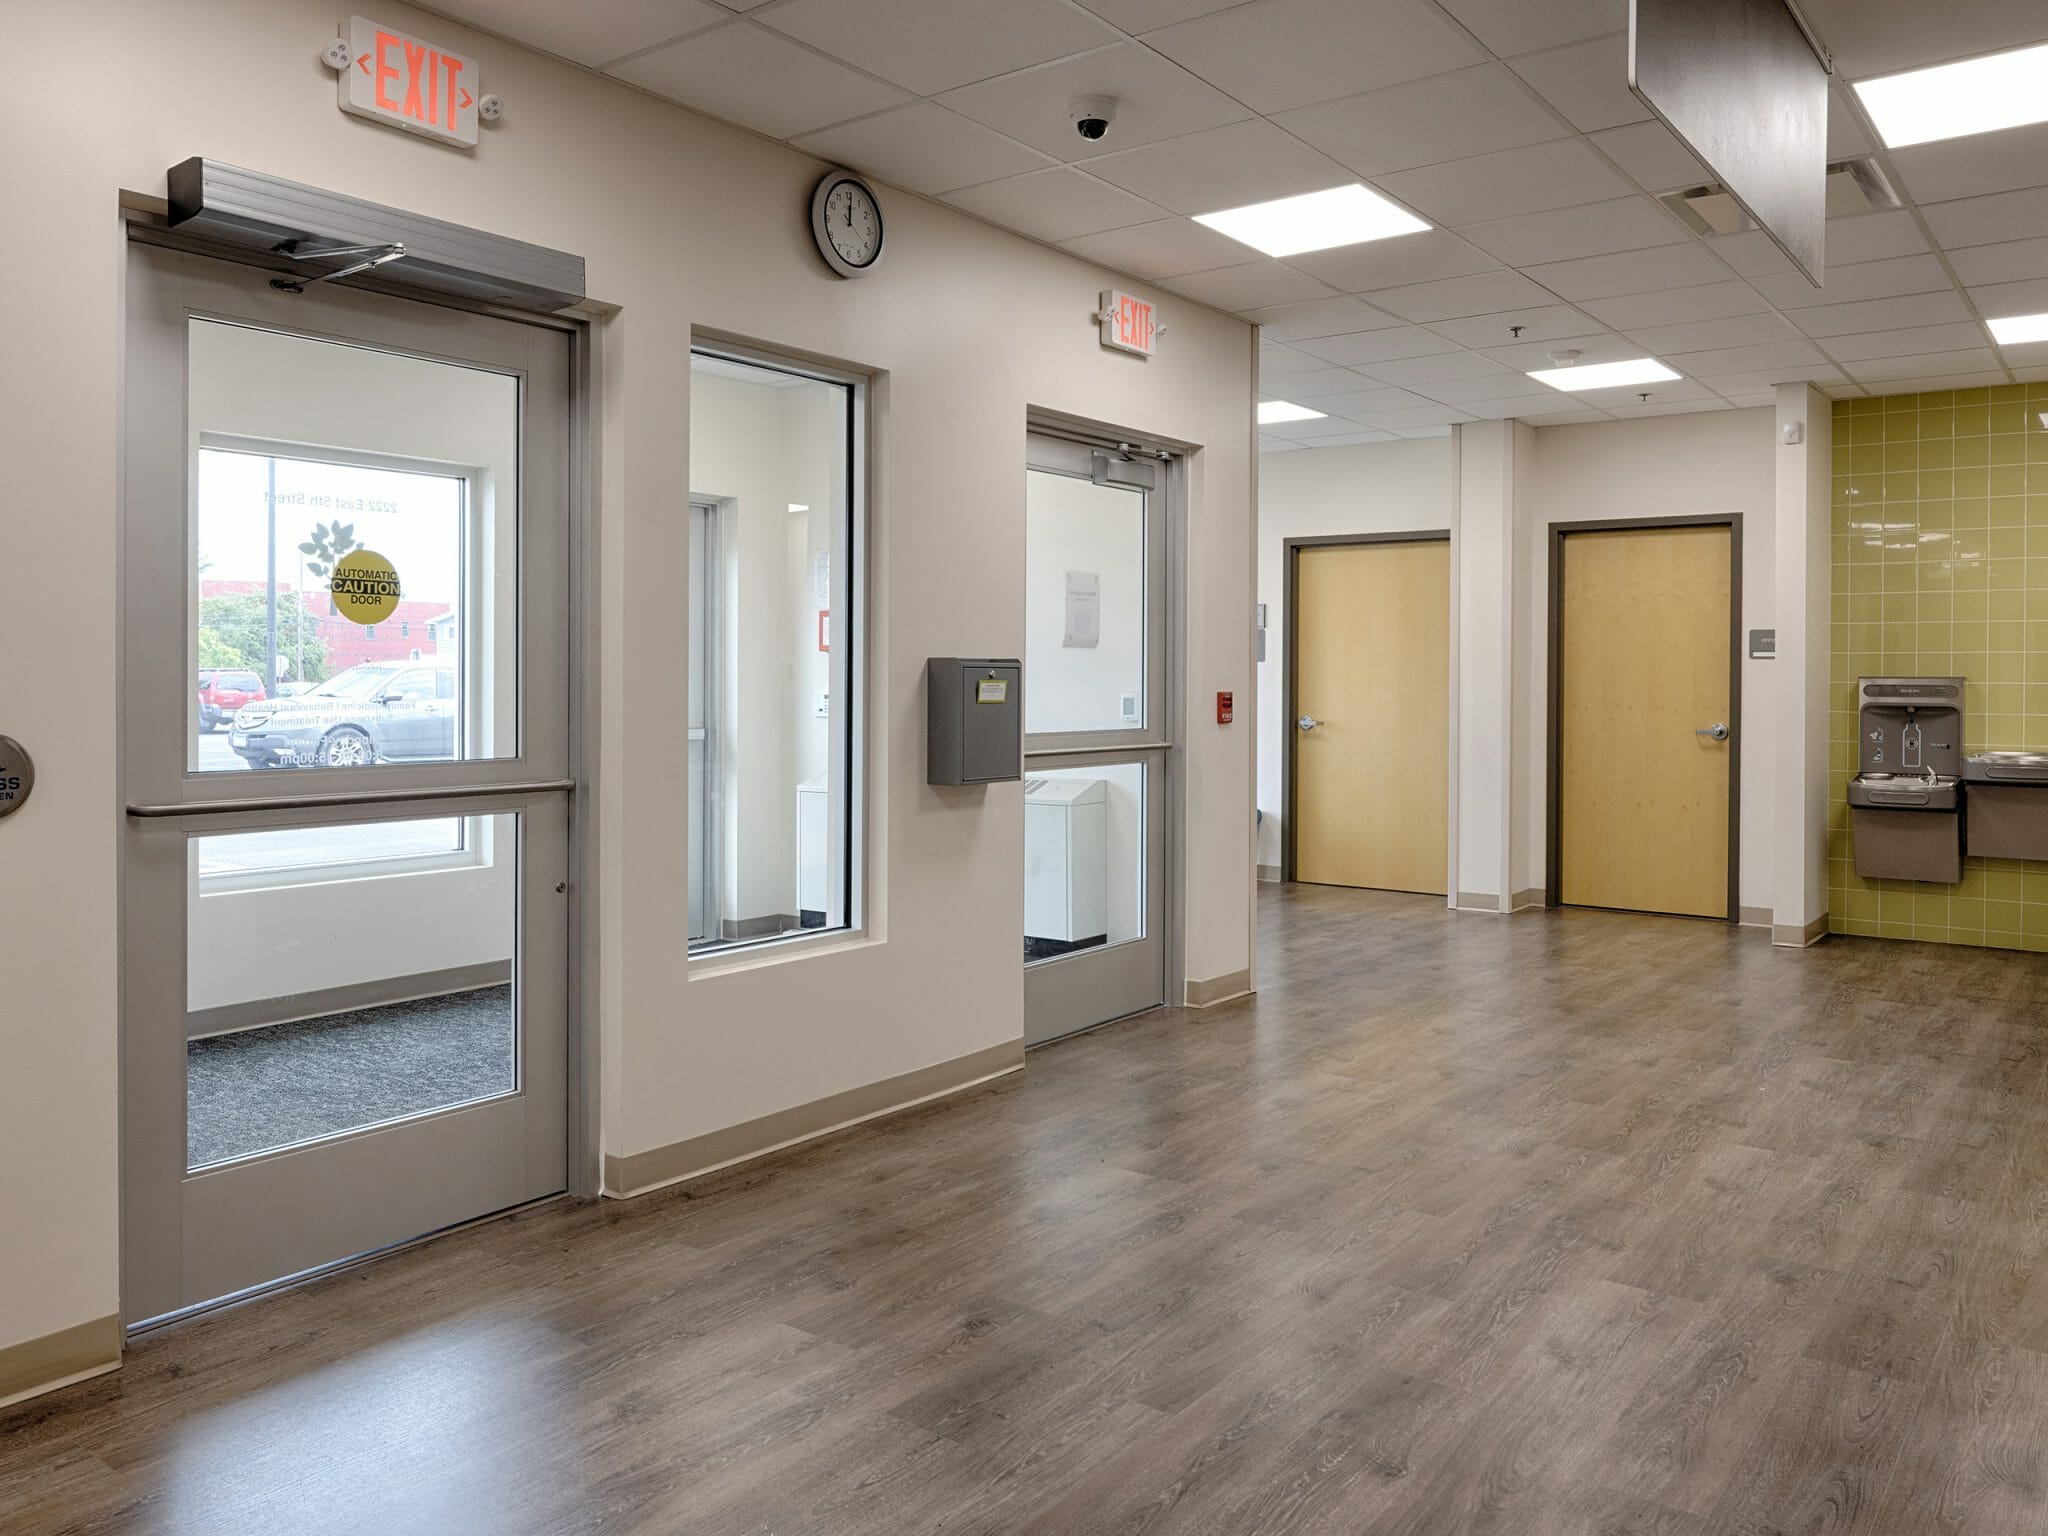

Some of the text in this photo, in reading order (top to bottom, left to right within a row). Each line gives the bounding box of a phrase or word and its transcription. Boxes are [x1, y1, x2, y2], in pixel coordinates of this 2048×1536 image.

[376, 31, 463, 132] EXIT
[863, 211, 869, 220] 2
[866, 227, 871, 236] 3
[846, 249, 851, 258] 6
[856, 249, 862, 258] 5
[1121, 296, 1151, 352] EXIT
[335, 568, 398, 581] AUTOMATIC
[332, 579, 400, 595] CAUTION
[351, 595, 382, 605] DOOR
